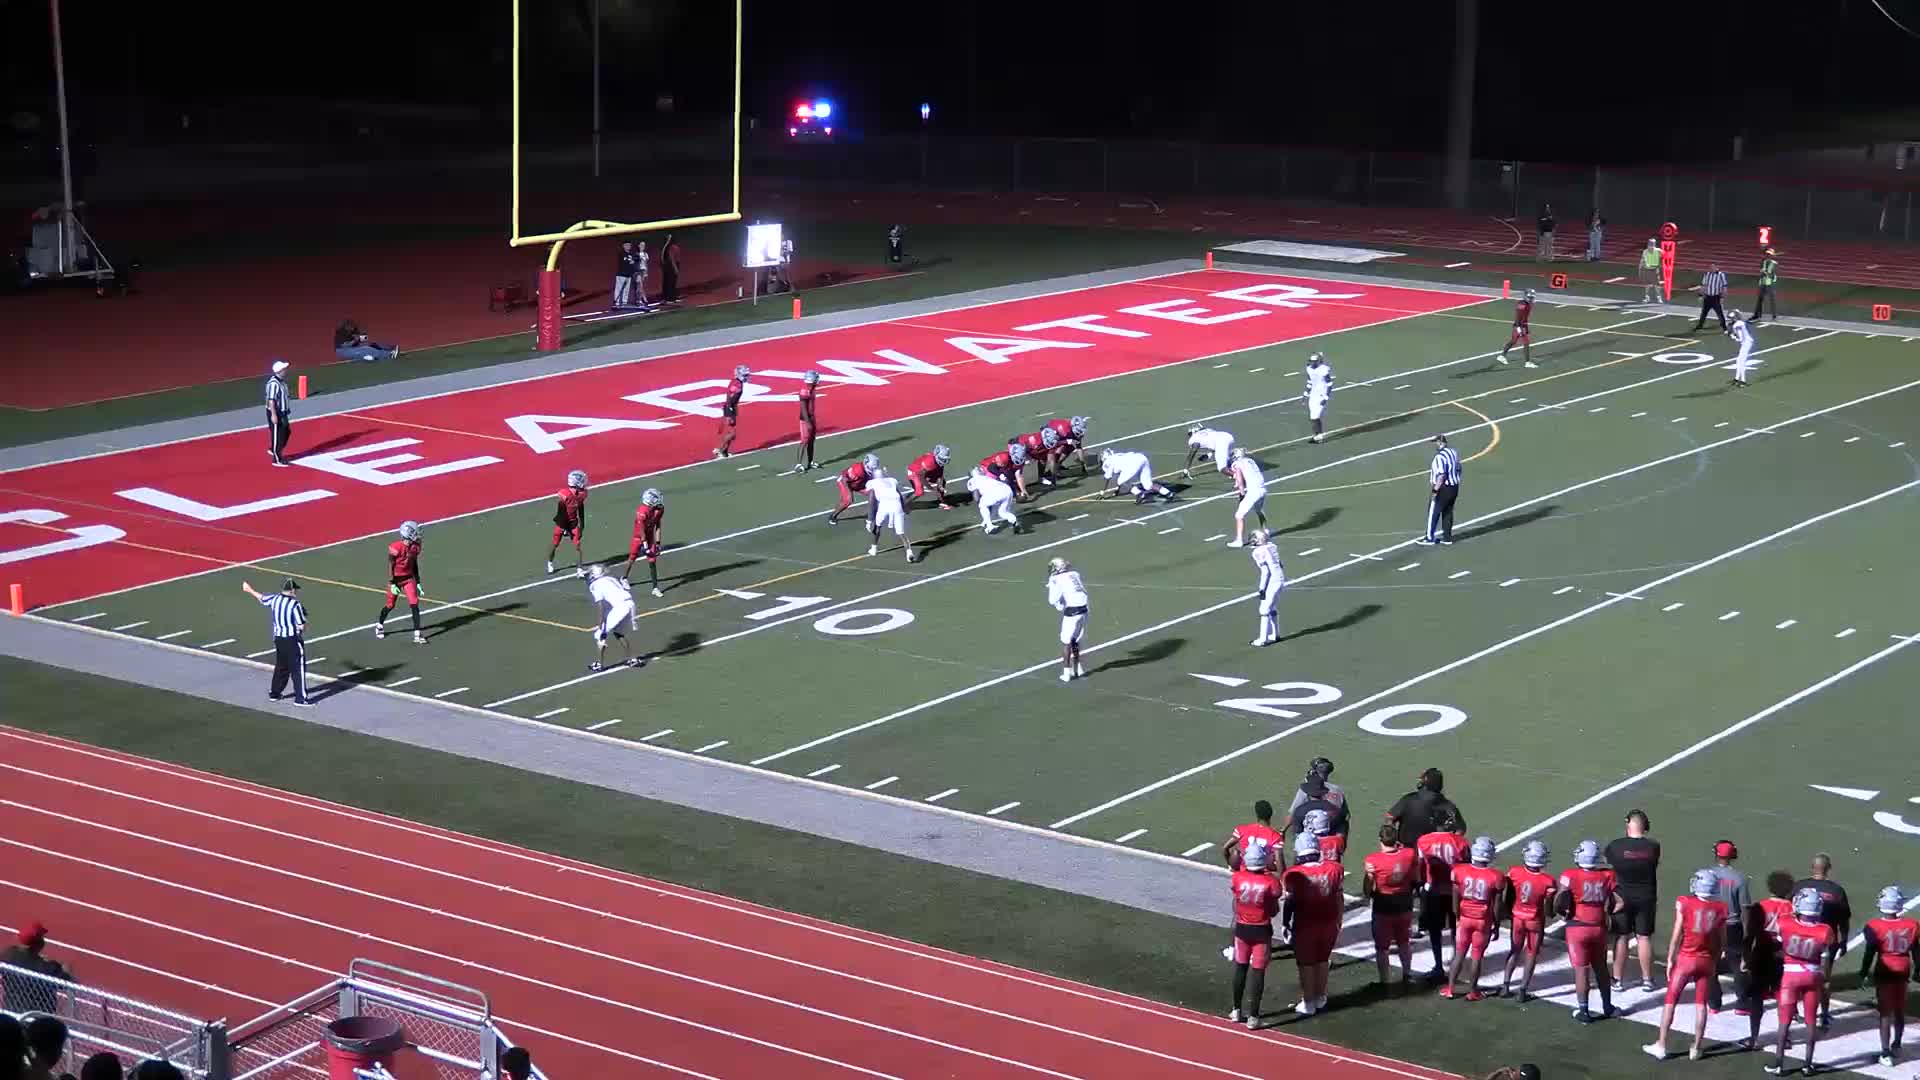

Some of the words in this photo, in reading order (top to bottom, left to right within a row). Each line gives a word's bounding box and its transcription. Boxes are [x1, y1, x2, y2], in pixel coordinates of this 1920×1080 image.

[1759, 227, 1769, 243] 2
[1552, 275, 1564, 287] G
[1875, 306, 1889, 319] 10
[743, 596, 915, 635] 10
[1213, 681, 1467, 736] 20
[1240, 881, 1265, 903] 27
